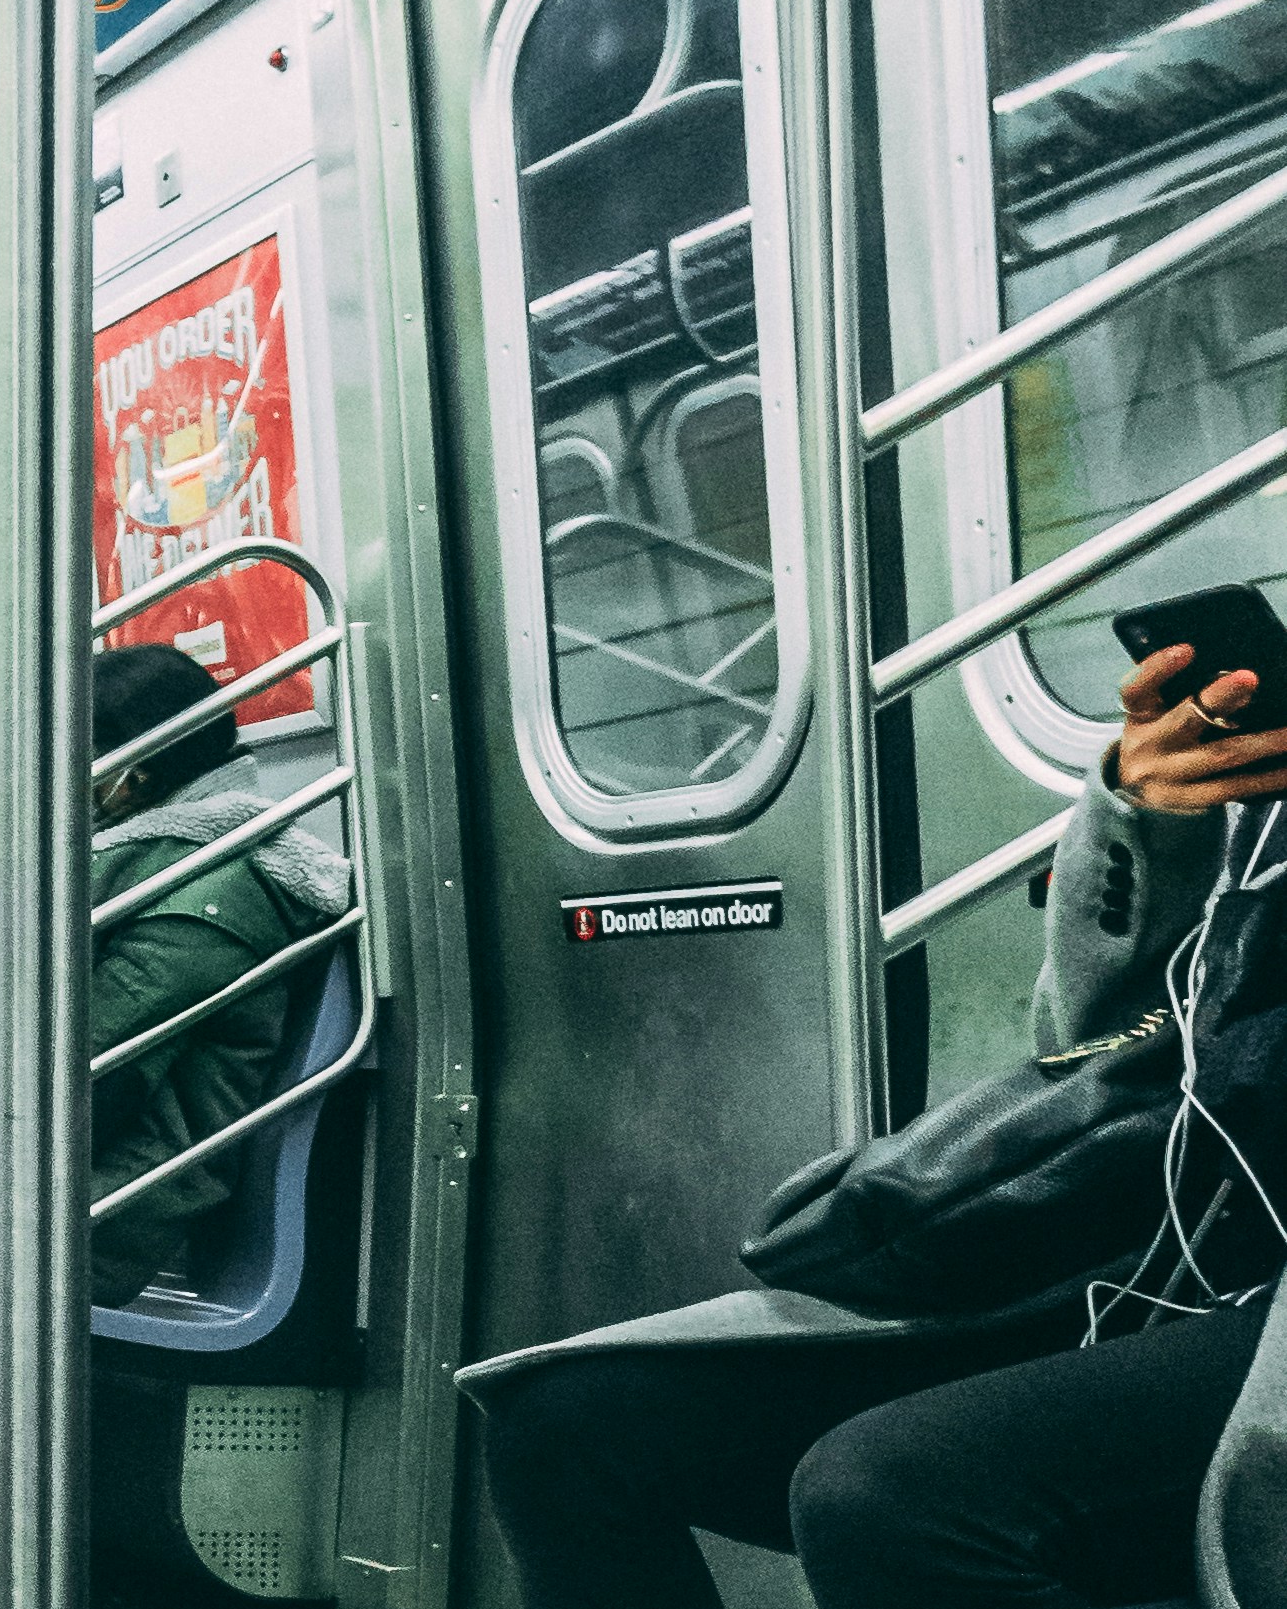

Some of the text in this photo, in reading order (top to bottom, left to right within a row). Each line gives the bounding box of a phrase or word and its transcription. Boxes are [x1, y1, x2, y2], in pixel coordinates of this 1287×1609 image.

[100, 286, 262, 449] YOU ORDER
[601, 899, 773, 933] Do not lean on door
